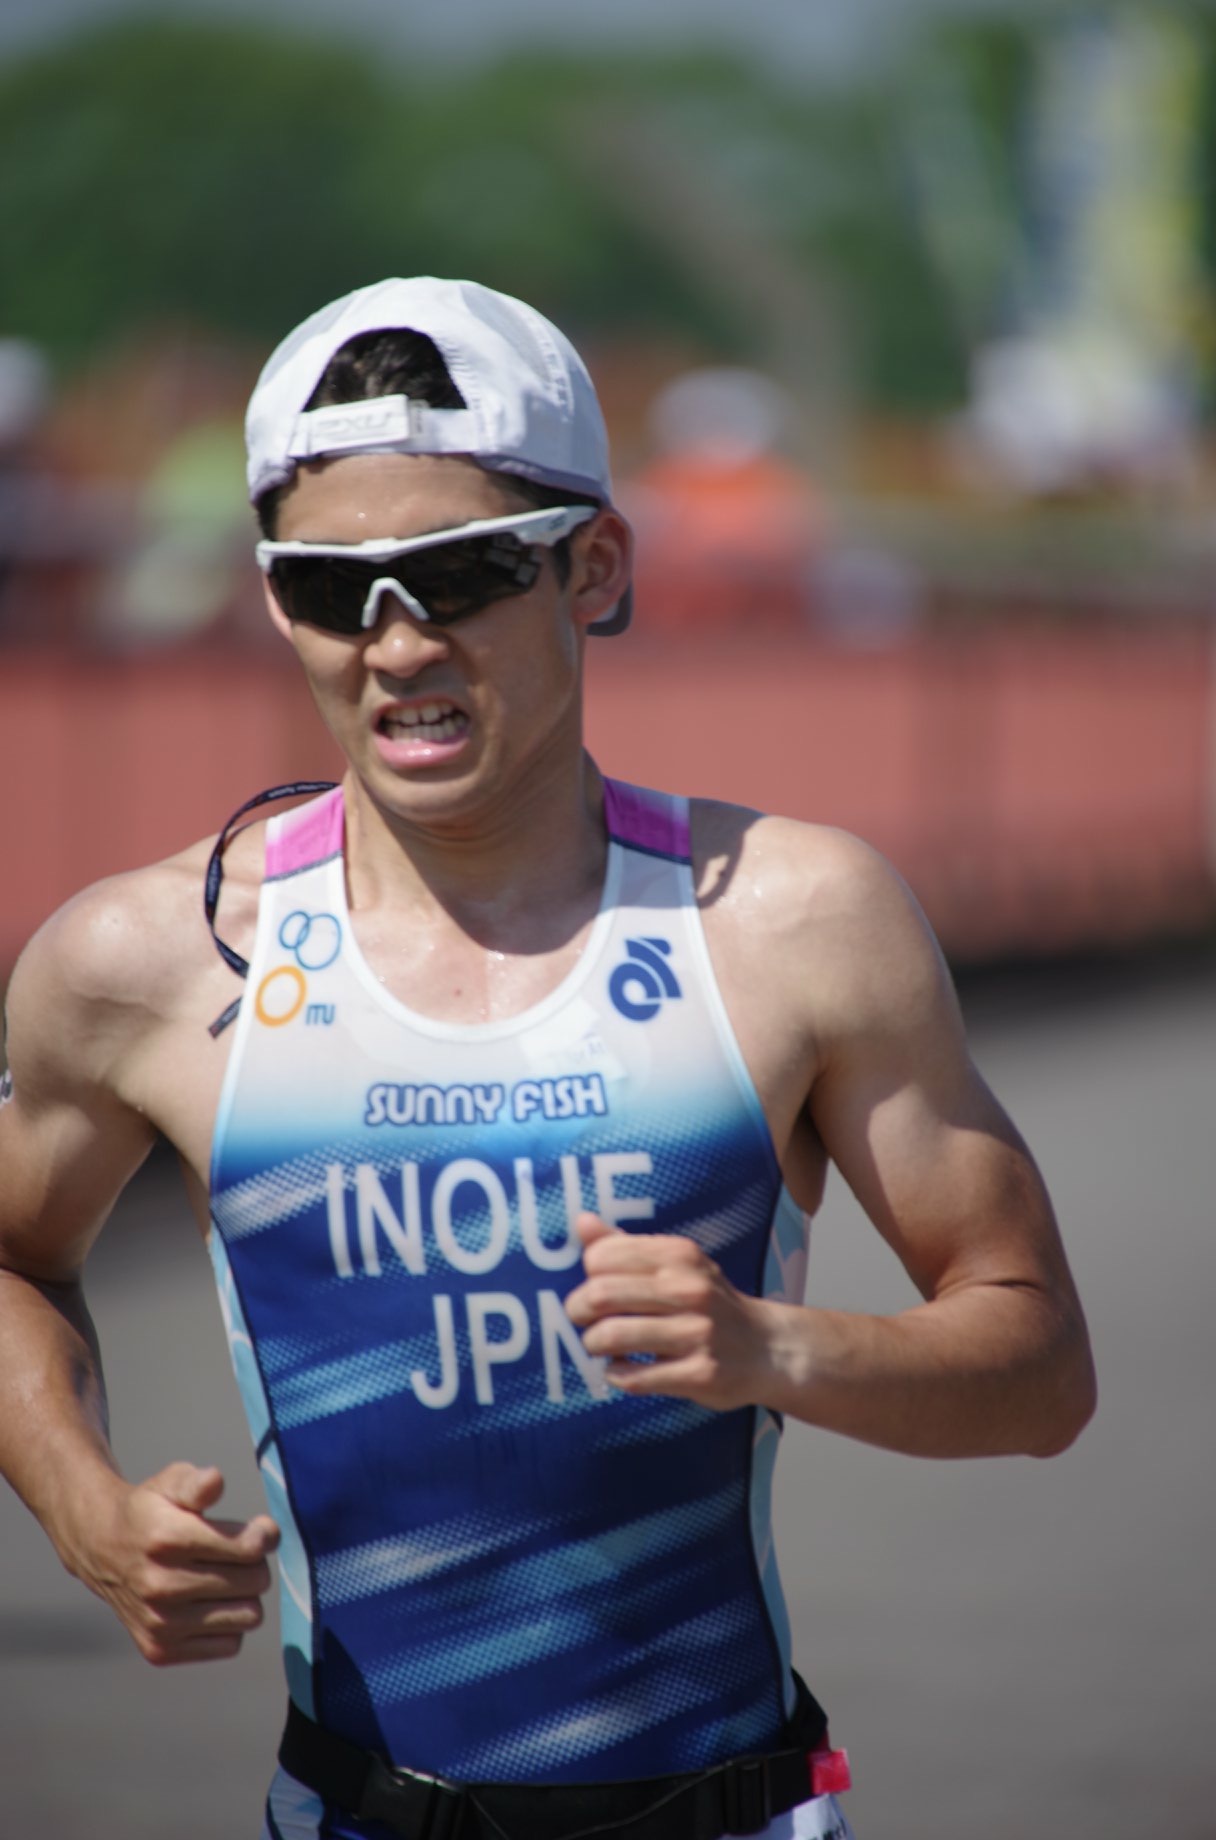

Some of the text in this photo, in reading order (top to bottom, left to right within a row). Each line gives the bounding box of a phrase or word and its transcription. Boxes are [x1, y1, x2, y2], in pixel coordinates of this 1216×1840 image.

[305, 1003, 336, 1025] ITU
[365, 1073, 608, 1126] SUNNY FISH
